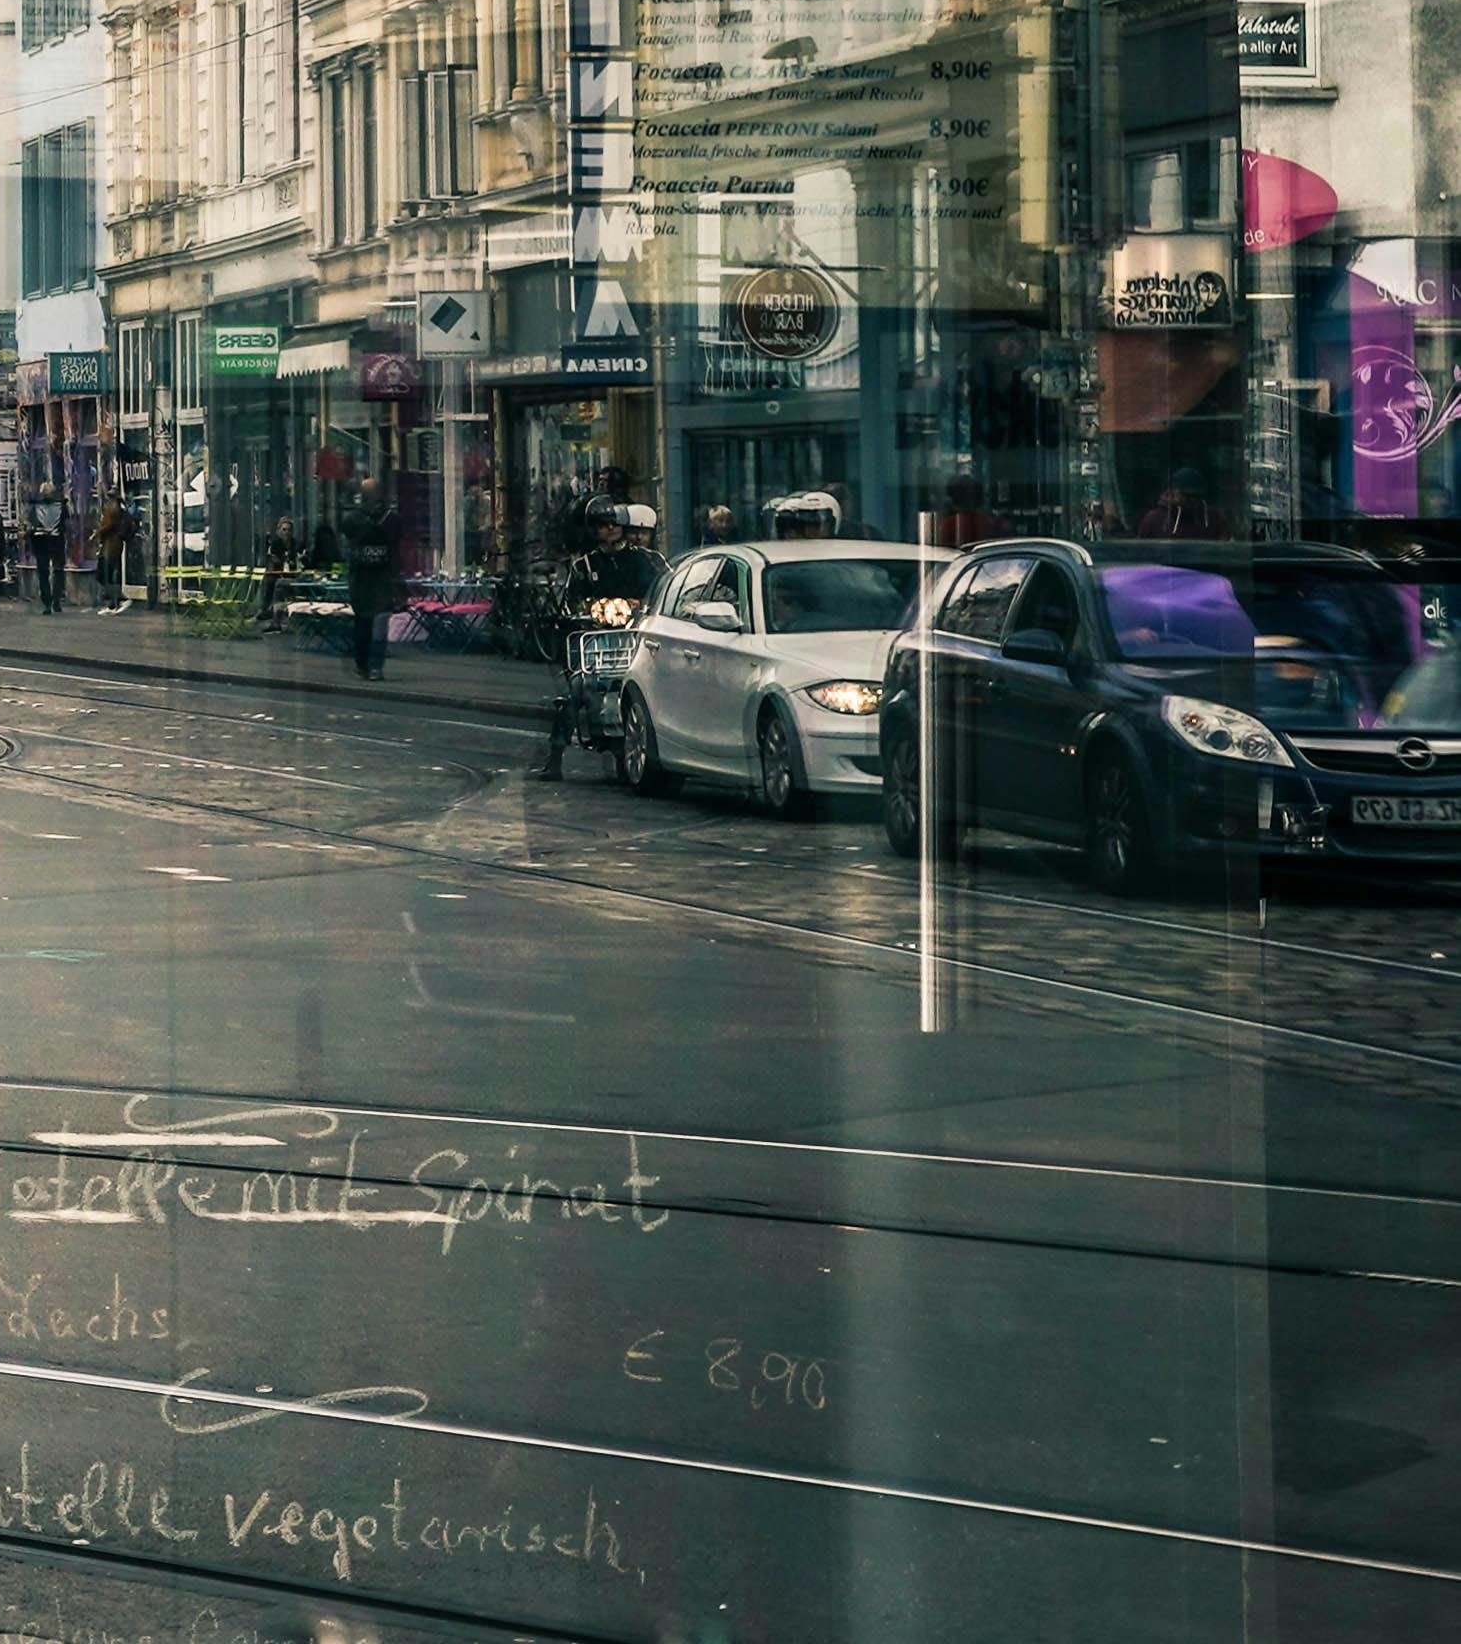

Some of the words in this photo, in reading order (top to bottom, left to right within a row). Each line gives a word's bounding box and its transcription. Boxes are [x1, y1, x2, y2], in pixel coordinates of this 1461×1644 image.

[1250, 41, 1276, 54] aller
[1280, 40, 1297, 54] Art
[633, 62, 723, 81] Focaccia
[930, 60, 992, 81] 8,90€
[869, 87, 924, 101] Rucola
[632, 119, 721, 137] Focaccia
[725, 122, 818, 136] PEPERONI
[822, 123, 879, 137] Salami
[929, 119, 991, 140] 8,90€
[867, 145, 923, 159] Rucola
[628, 176, 718, 194] Focaccia
[725, 176, 795, 194] Parma
[972, 206, 1003, 219] und
[242, 1130, 380, 1226] mit
[410, 1127, 670, 1254] Spinat
[623, 1329, 665, 1383] €
[704, 1337, 826, 1411] 8,90
